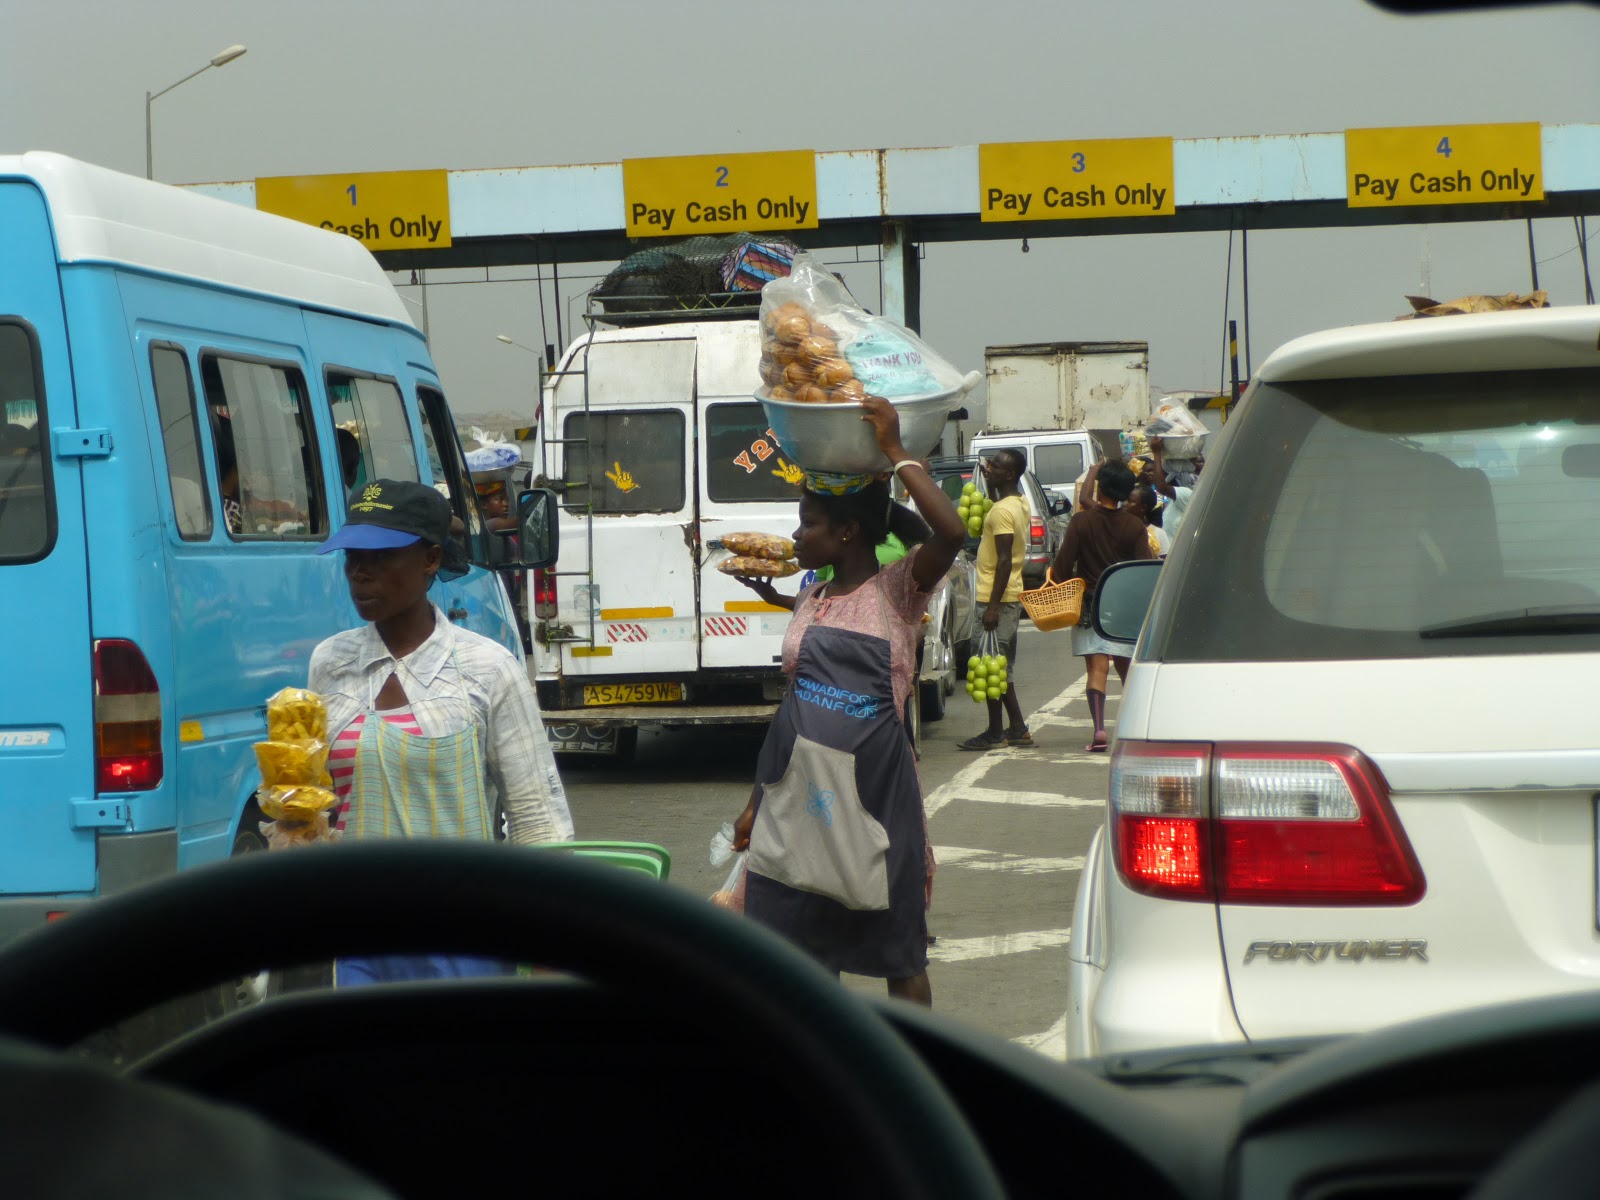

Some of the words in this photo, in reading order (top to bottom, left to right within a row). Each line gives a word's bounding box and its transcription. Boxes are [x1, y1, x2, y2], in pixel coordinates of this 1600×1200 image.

[1436, 136, 1452, 158] 4
[1071, 152, 1086, 173] 3
[715, 166, 729, 187] 2
[1354, 173, 1399, 201] Pay
[1410, 170, 1472, 194] Cash
[1481, 168, 1535, 196] Only
[346, 184, 357, 206] 1
[988, 188, 1032, 215] Pay
[1043, 184, 1105, 208] Cash
[1114, 183, 1167, 210] Only
[632, 203, 675, 230] Pay
[686, 199, 747, 223] Cash
[757, 195, 809, 224] Only
[389, 214, 442, 242] Only
[0, 731, 51, 746] TER
[1243, 938, 1430, 966] FORTUNER
